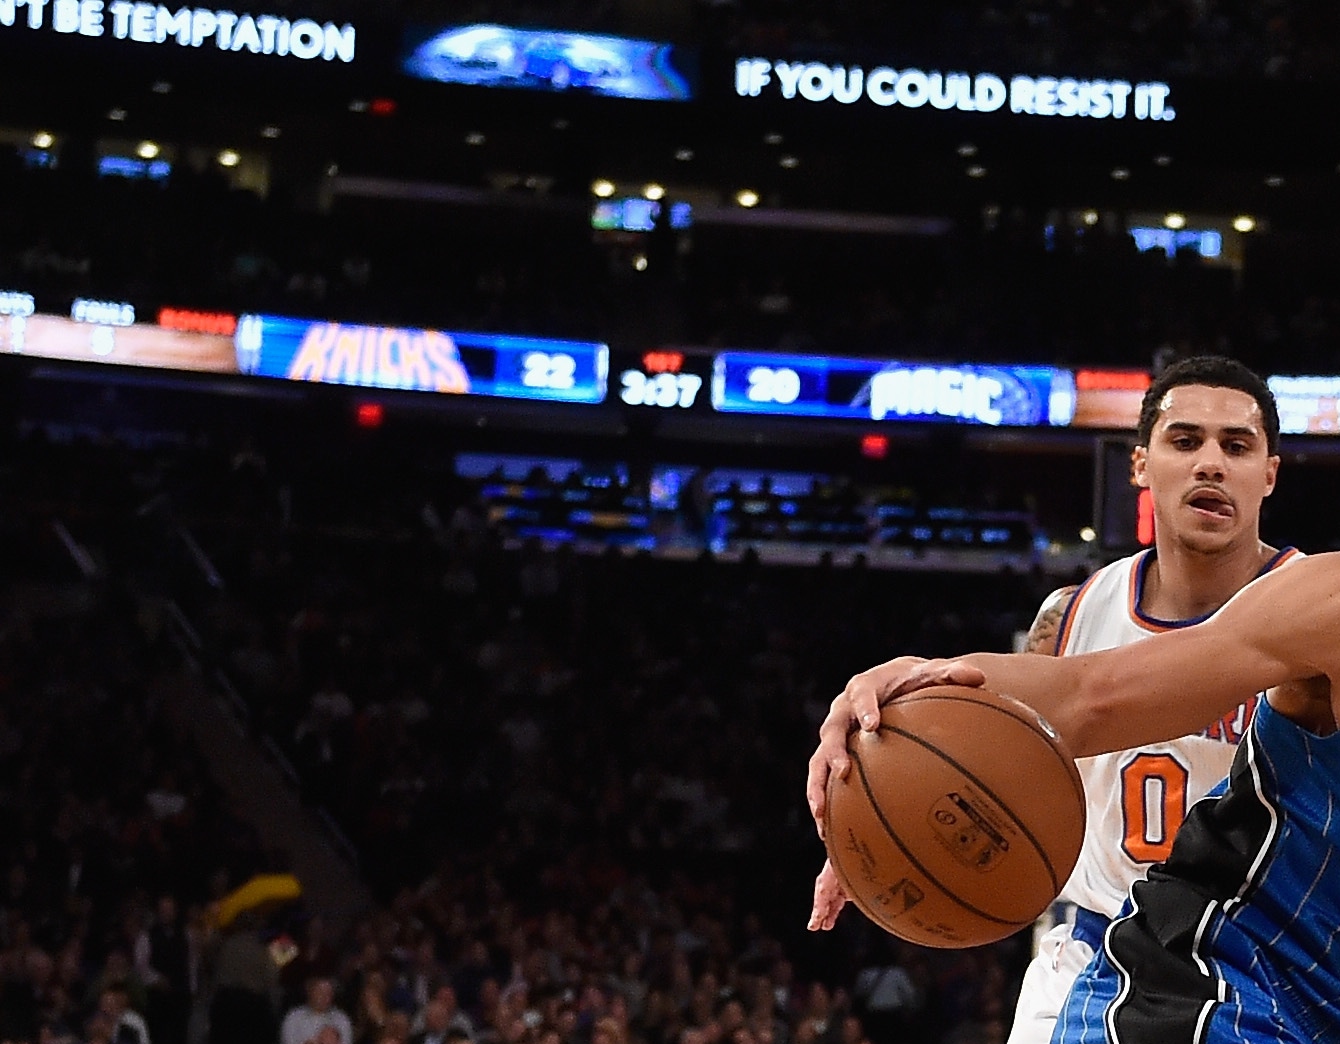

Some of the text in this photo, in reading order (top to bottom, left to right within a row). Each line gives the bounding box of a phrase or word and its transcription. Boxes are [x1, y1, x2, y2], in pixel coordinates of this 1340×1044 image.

[53, 0, 105, 36] BE
[108, 0, 356, 62] TEMPTATION
[735, 57, 1176, 121] IF YOU COULD RESIST IT.
[289, 323, 576, 395] KNICKS 22
[870, 368, 1002, 426] MAGIC
[1119, 752, 1189, 864] 0
